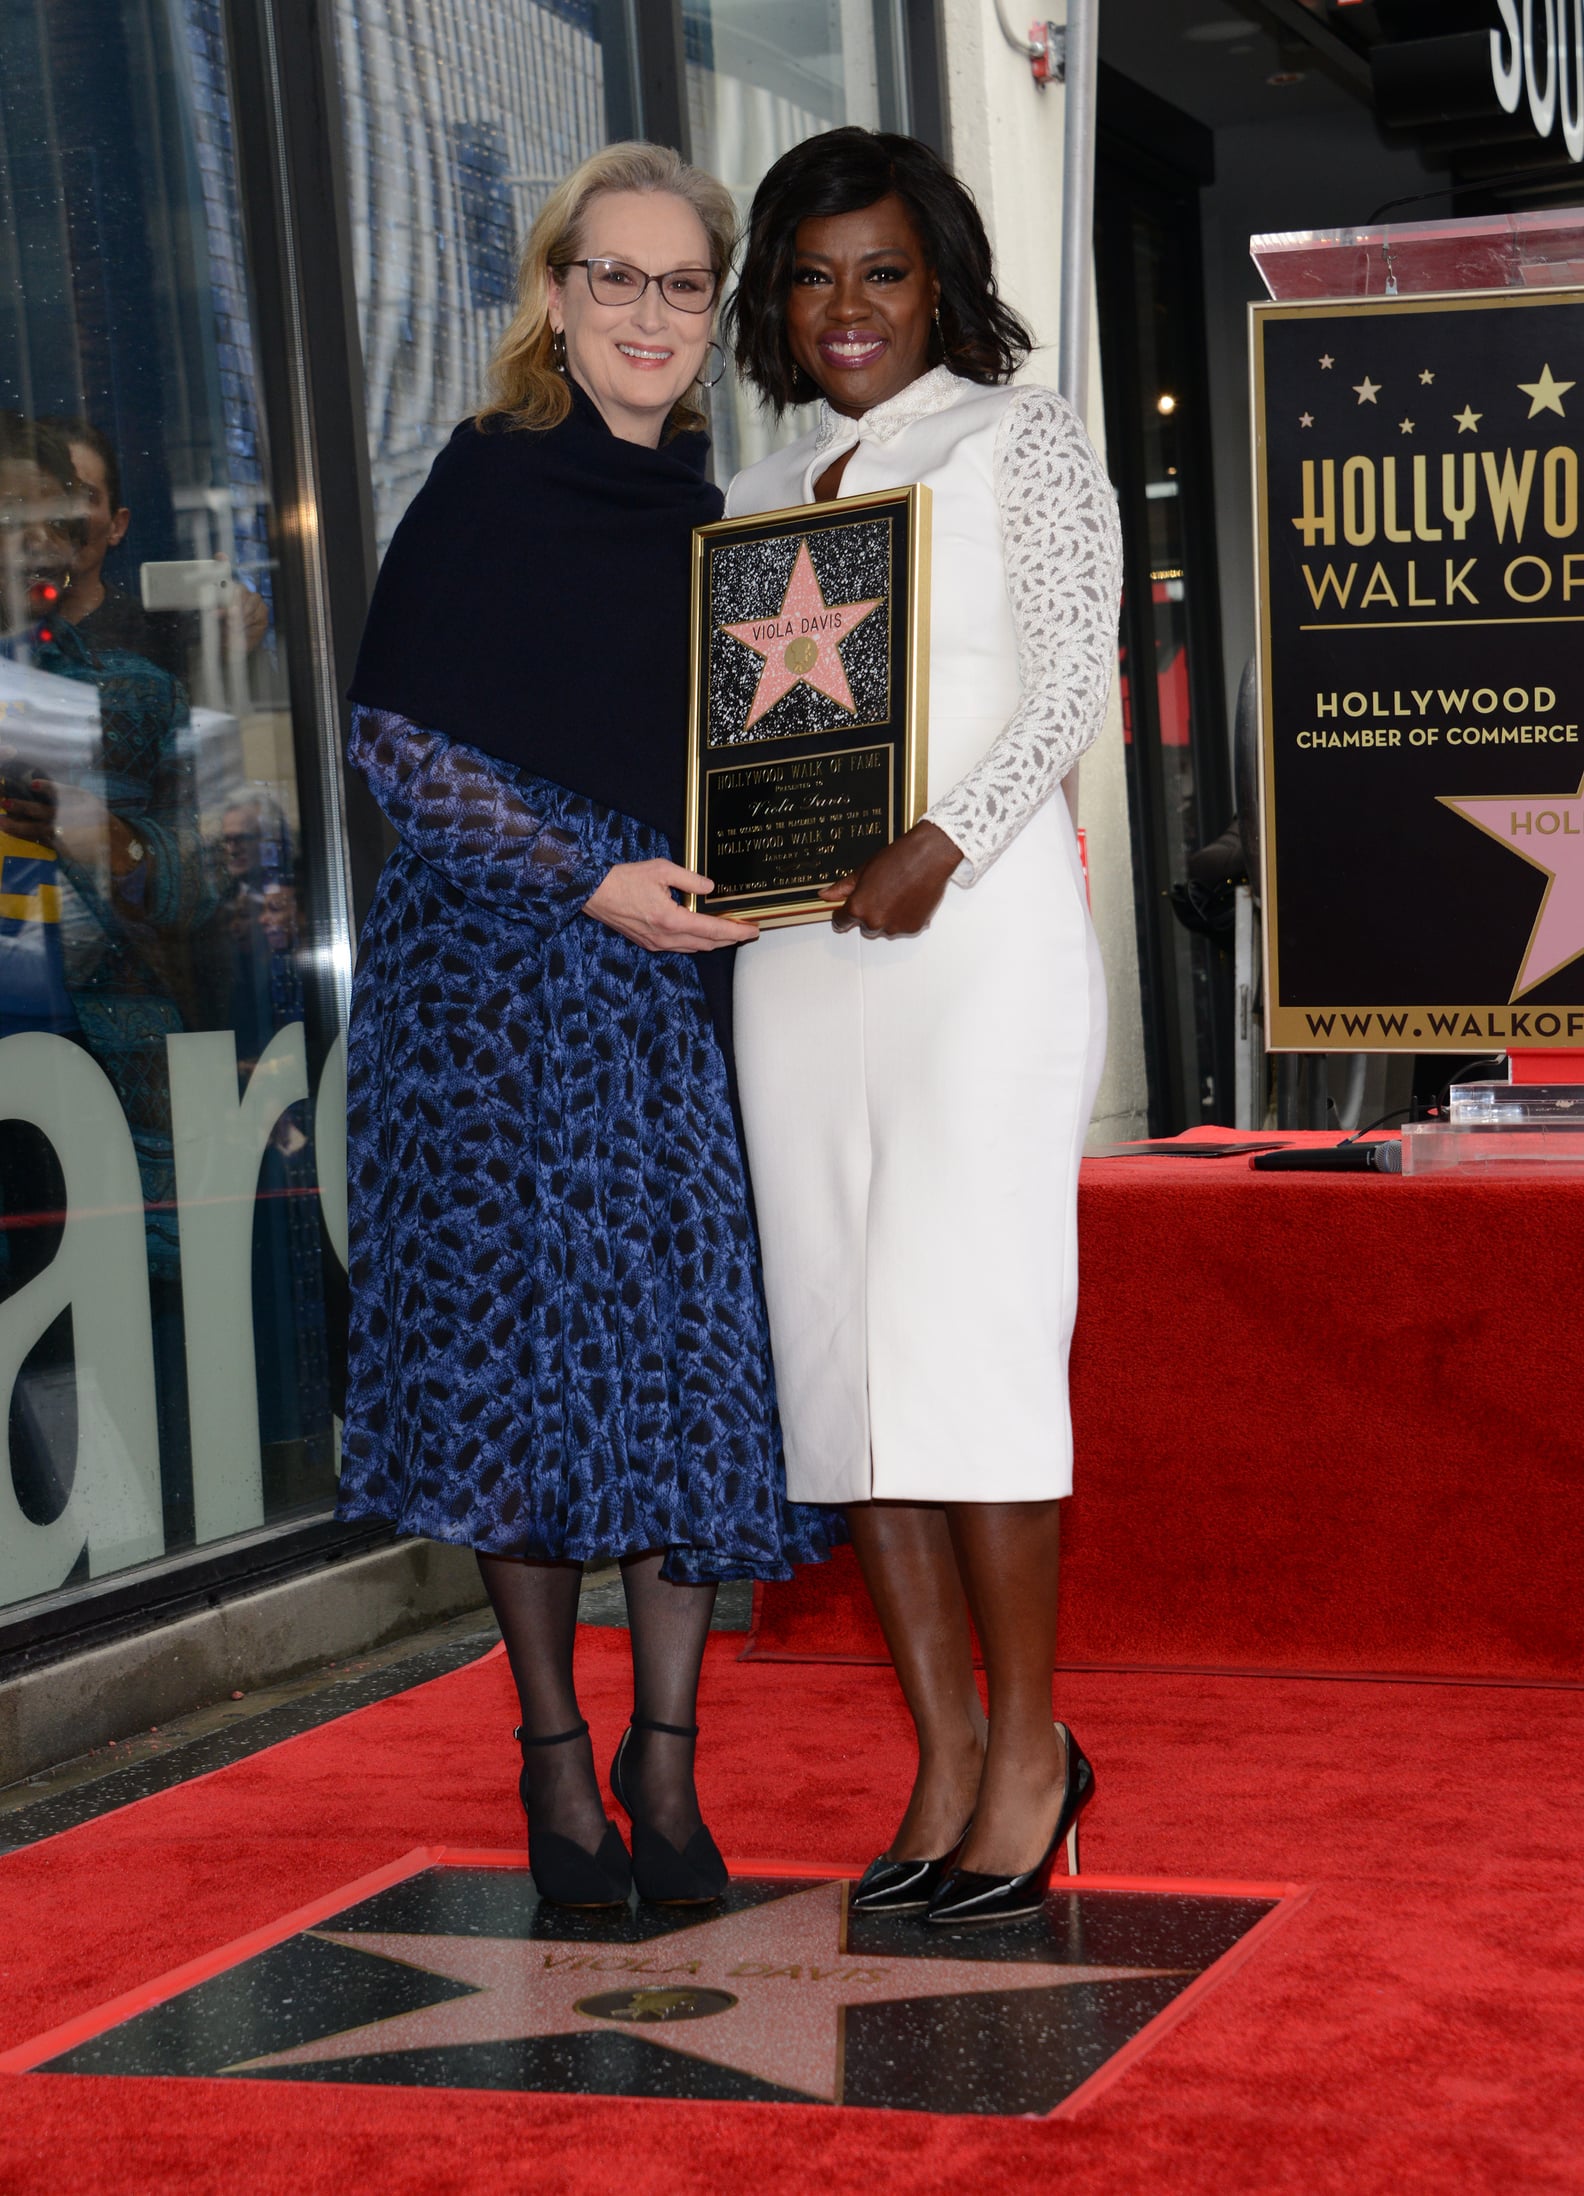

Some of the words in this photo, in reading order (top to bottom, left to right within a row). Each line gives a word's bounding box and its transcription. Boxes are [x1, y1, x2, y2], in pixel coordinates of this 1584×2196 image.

[1291, 446, 1578, 547] HOLLYWO
[1302, 558, 1480, 610] WALK
[1504, 553, 1584, 603] OF
[752, 621, 794, 641] VIOLA
[801, 612, 843, 634] DAVIS
[1316, 687, 1557, 718] HOLLYWOOD
[1296, 729, 1401, 749] CHAMBER
[1408, 728, 1440, 746] OF
[1446, 725, 1580, 745] COMMERCE
[717, 768, 784, 791] HOLLYWOOD
[791, 760, 822, 779] WALK
[830, 758, 843, 774] OF
[850, 752, 881, 772] FAME
[717, 836, 784, 856] HOLLYWOOD
[791, 830, 822, 846] WALK
[830, 828, 843, 840] OF
[850, 822, 882, 838] FAME
[542, 1953, 700, 1975] VIOLA
[725, 1961, 891, 1983] DAVIS
